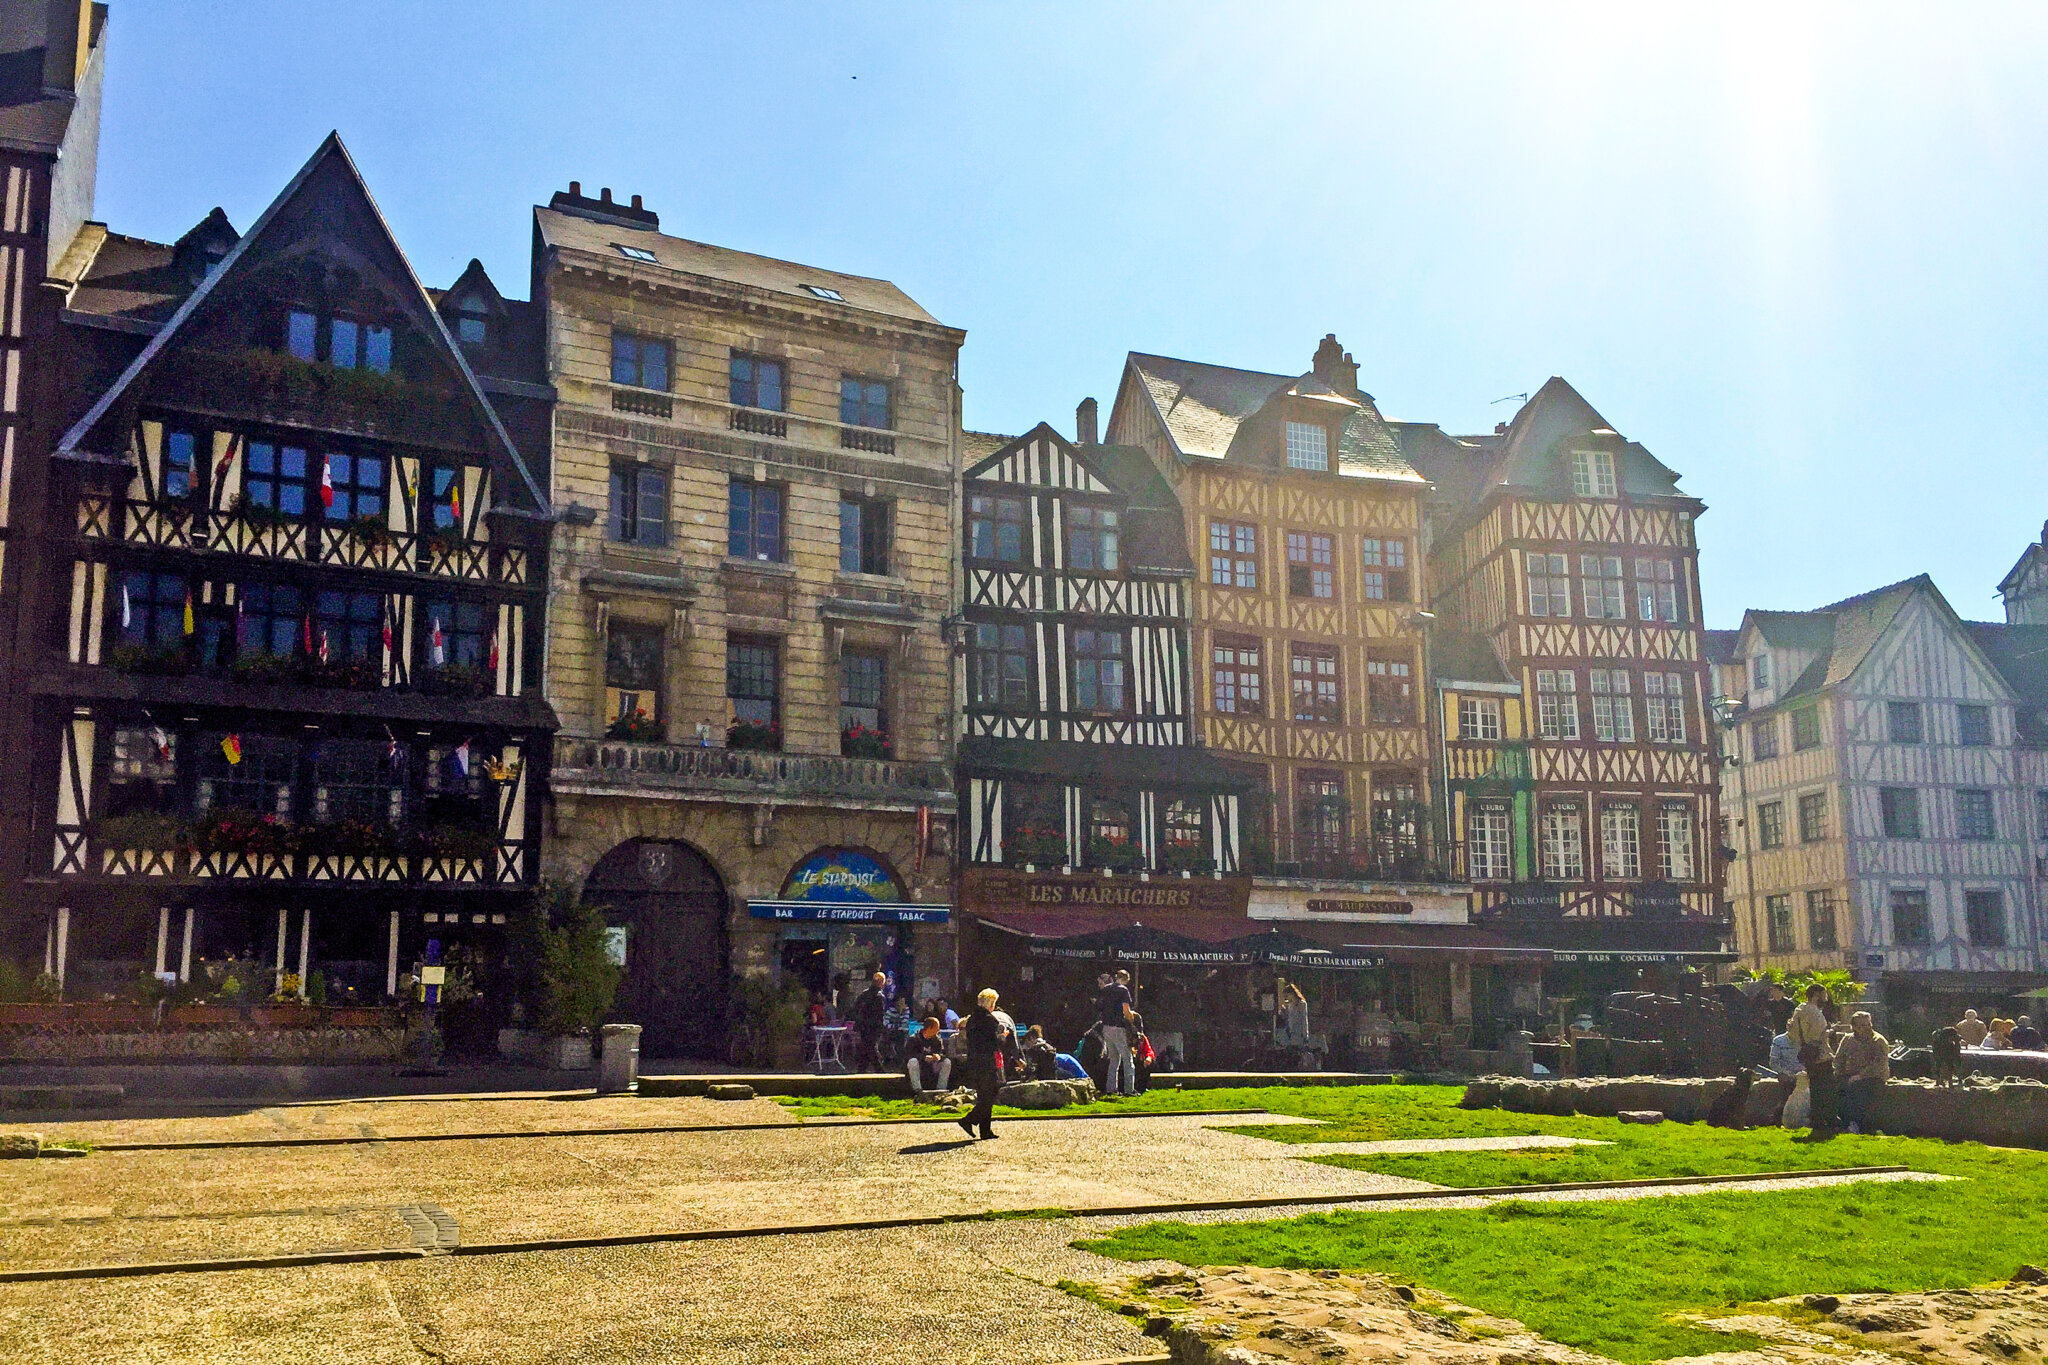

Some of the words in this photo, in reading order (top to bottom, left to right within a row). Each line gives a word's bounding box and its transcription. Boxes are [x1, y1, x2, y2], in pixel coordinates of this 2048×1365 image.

[801, 868, 817, 886] LE
[821, 872, 875, 886] STARDUST
[1030, 885, 1064, 903] LES
[1070, 886, 1190, 906] MARAICHERS
[1318, 901, 1330, 910] LE
[775, 909, 793, 918] BAR
[817, 909, 827, 919] LE
[830, 910, 876, 920] STARDUST
[898, 912, 925, 921] TABAC
[1118, 950, 1140, 960] Depuis
[1141, 951, 1157, 960] 1912
[1163, 952, 1178, 960] LES
[1179, 953, 1234, 961] MARAICHERS
[1553, 954, 1577, 962] EURO
[1588, 954, 1610, 962] BARS
[1620, 954, 1666, 962] COCKTAILS
[1308, 957, 1323, 965] LES
[1323, 957, 1372, 967] MARAICHERS
